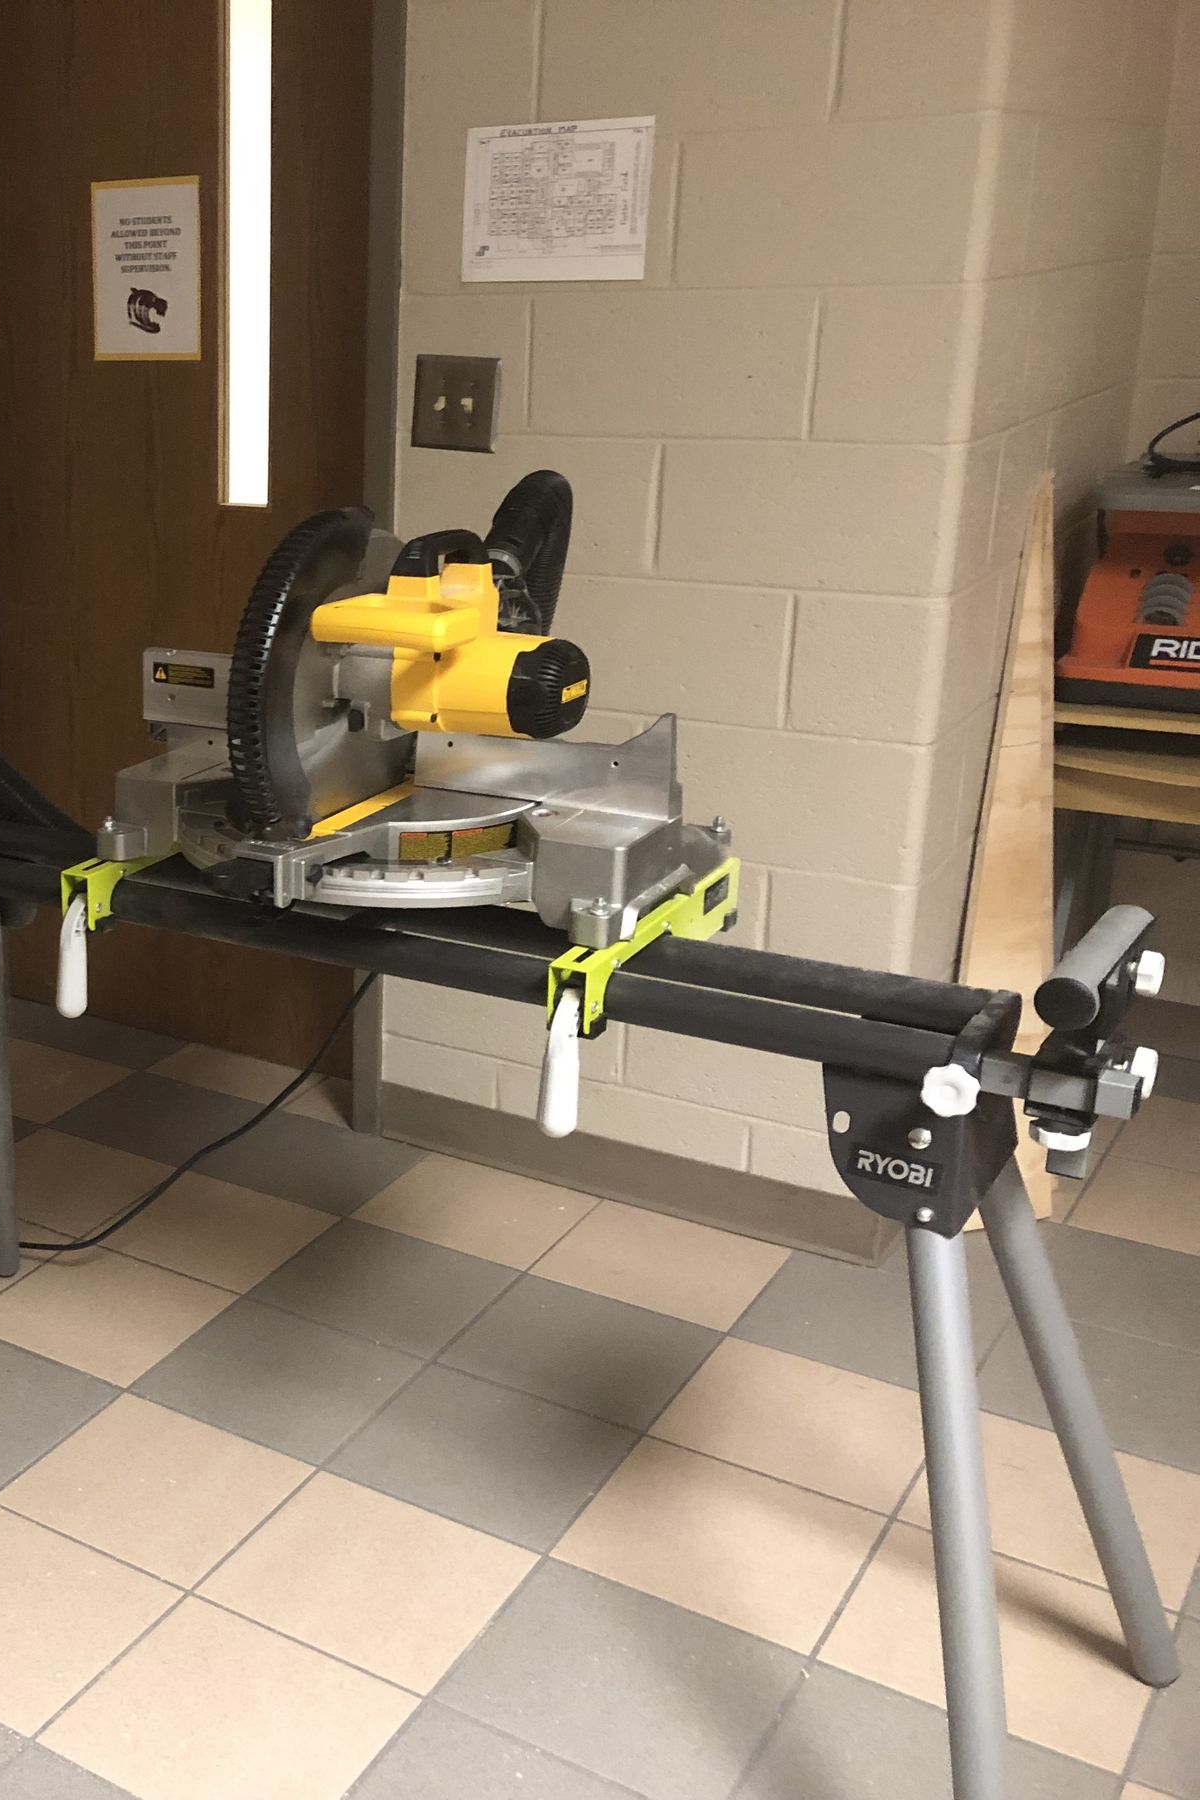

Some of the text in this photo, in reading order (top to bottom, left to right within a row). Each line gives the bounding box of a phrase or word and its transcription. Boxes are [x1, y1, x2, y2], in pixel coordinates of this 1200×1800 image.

[119, 216, 172, 226] NO STUDENTS
[111, 227, 181, 238] ALLOWED BEYOND
[124, 240, 168, 249] THIS POINT
[114, 252, 177, 262] WITHOUT STAFF
[857, 1149, 934, 1188] RYOBI
